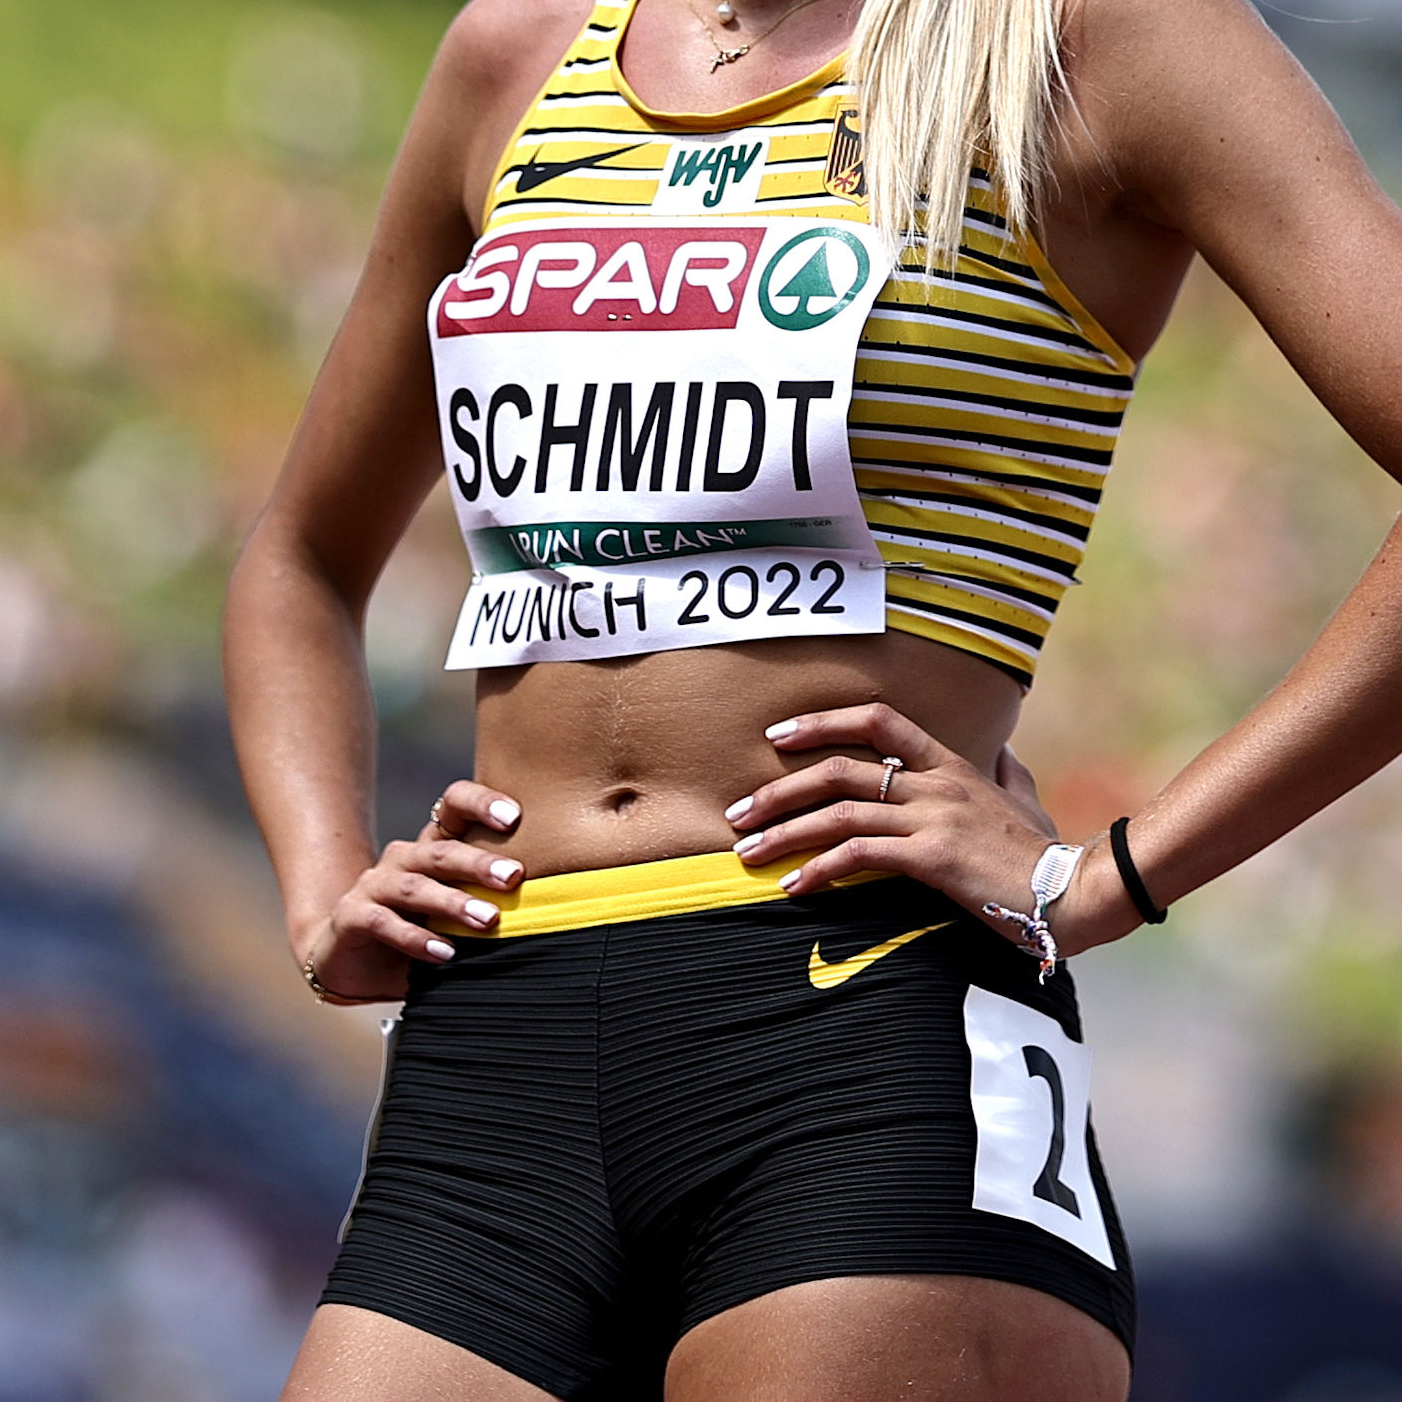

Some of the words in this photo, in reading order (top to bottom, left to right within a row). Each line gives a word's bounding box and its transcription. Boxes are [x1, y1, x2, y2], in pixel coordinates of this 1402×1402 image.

[444, 240, 748, 320] SPAR
[449, 380, 834, 501] SCHMIDT
[469, 577, 647, 646] MUNICH
[676, 559, 845, 626] 2022
[1021, 1044, 1082, 1221] 2
